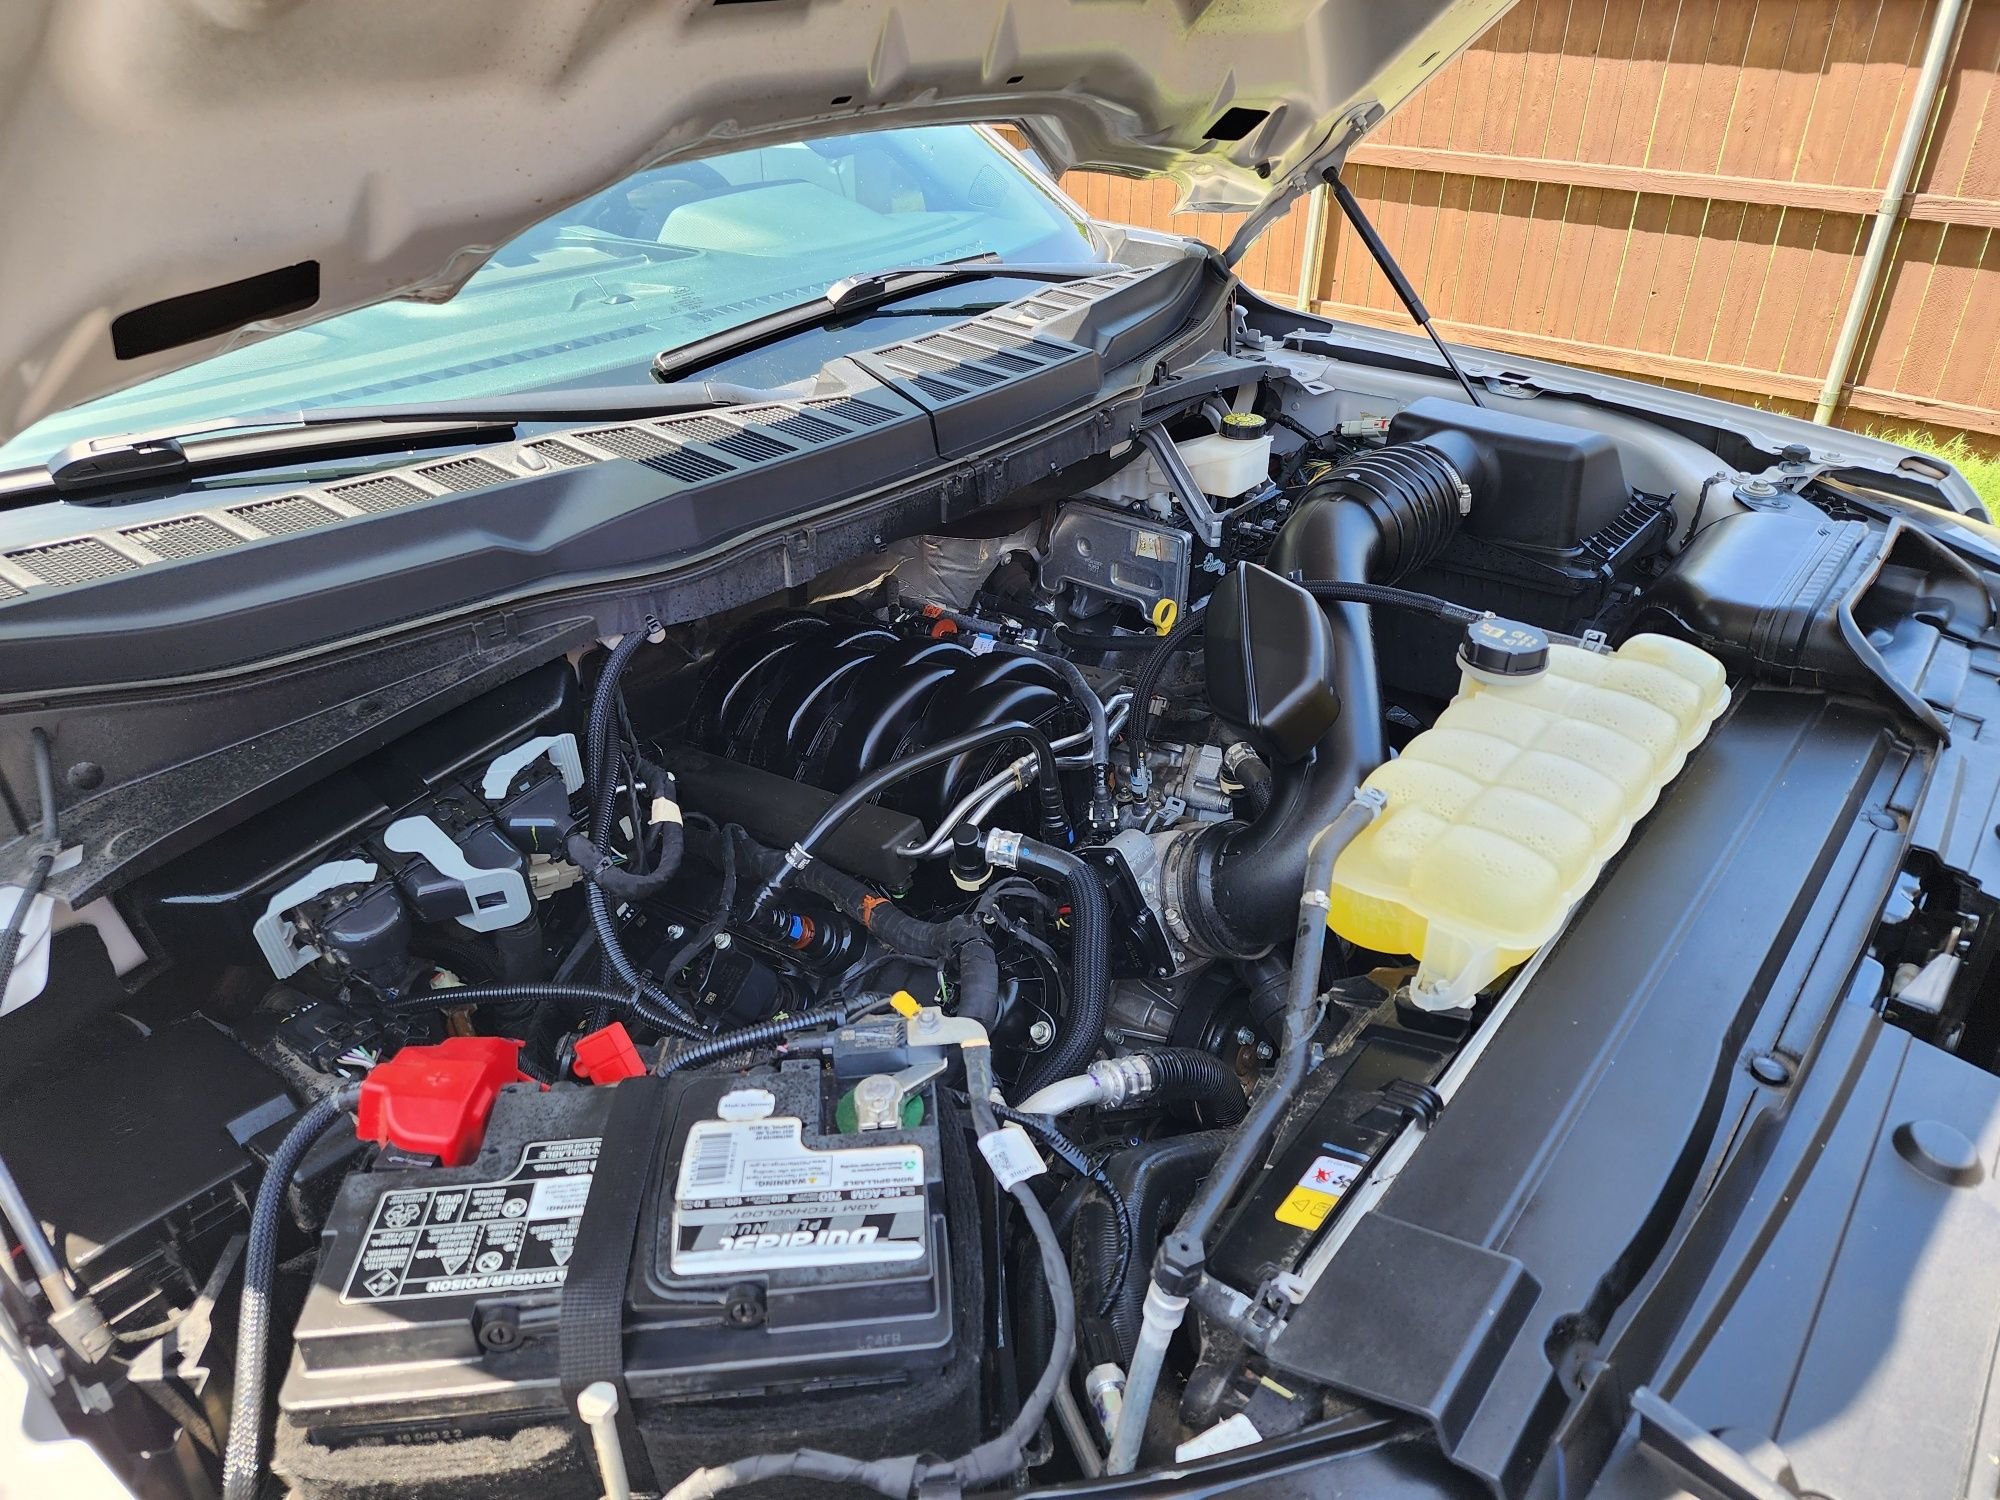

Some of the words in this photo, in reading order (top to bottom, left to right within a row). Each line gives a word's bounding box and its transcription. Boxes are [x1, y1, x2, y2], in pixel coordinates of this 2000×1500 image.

[754, 1178, 806, 1188] WARNING:
[728, 1205, 835, 1220] TECHNOLOGY
[843, 1203, 879, 1212] AGM
[722, 1219, 822, 1236] PLATINUM
[426, 1270, 556, 1292] DANGER/POISON
